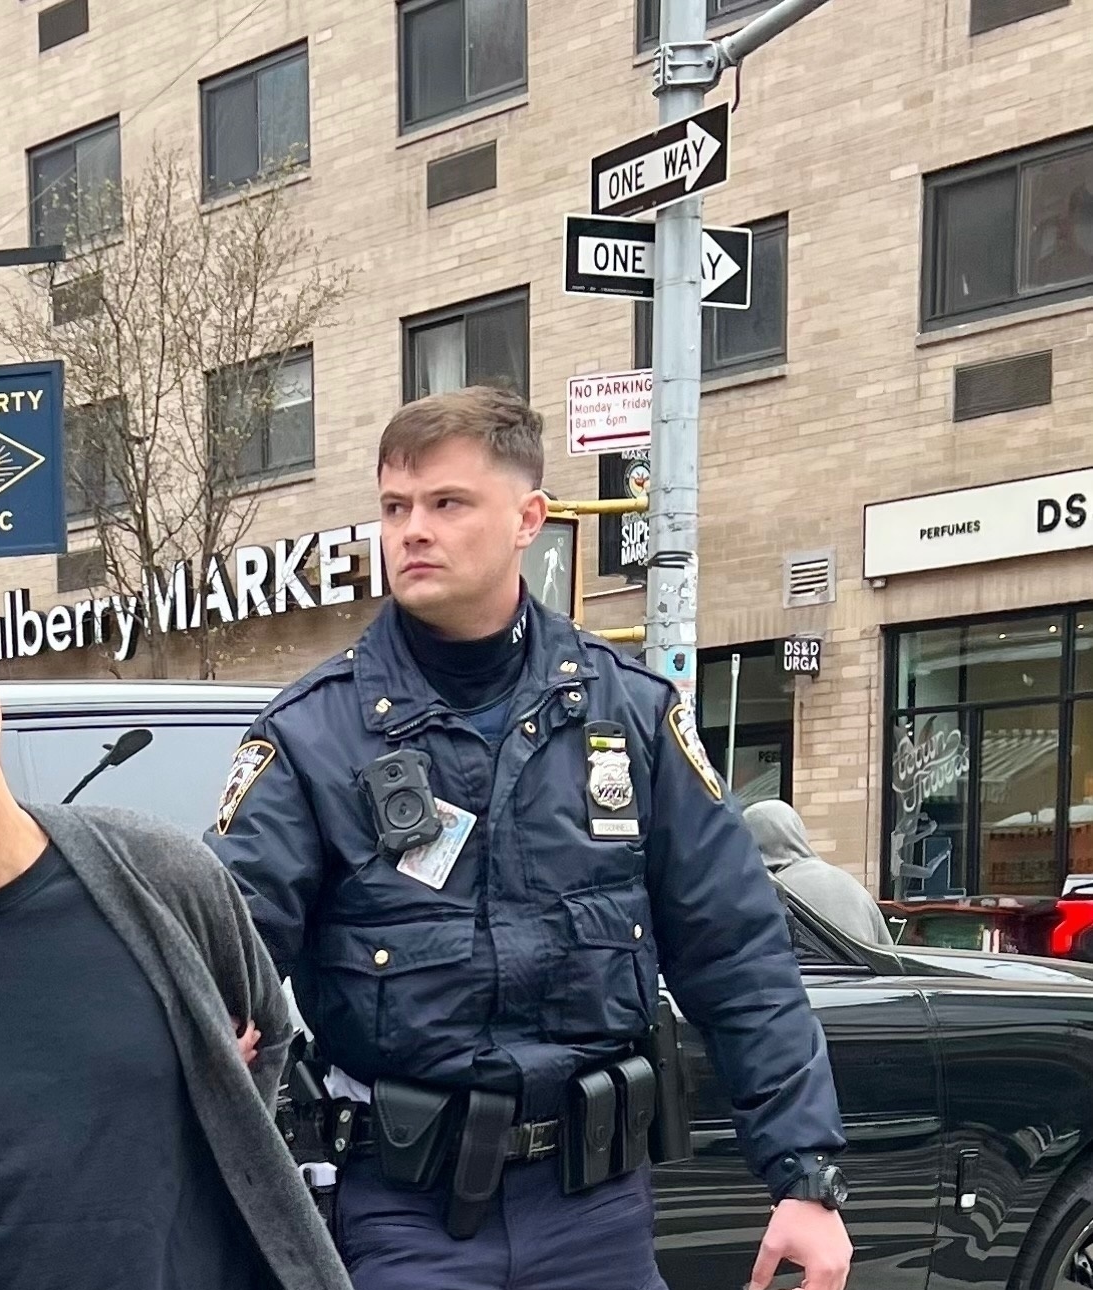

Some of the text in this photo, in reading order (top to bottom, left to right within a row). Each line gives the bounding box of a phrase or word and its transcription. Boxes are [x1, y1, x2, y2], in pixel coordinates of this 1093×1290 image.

[609, 136, 706, 200] ONE WAY
[594, 242, 646, 274] ONE
[575, 378, 653, 399] NO PARKING
[575, 401, 612, 415] Monday
[622, 397, 652, 411] Friday
[575, 416, 596, 429] 8am
[606, 414, 627, 428] 6pm
[621, 521, 649, 547] SUPE
[920, 520, 981, 540] PERFUMES
[621, 542, 648, 565] MARK
[142, 520, 383, 635] MARKET
[784, 641, 819, 656] DS&D
[784, 656, 818, 671] URGA
